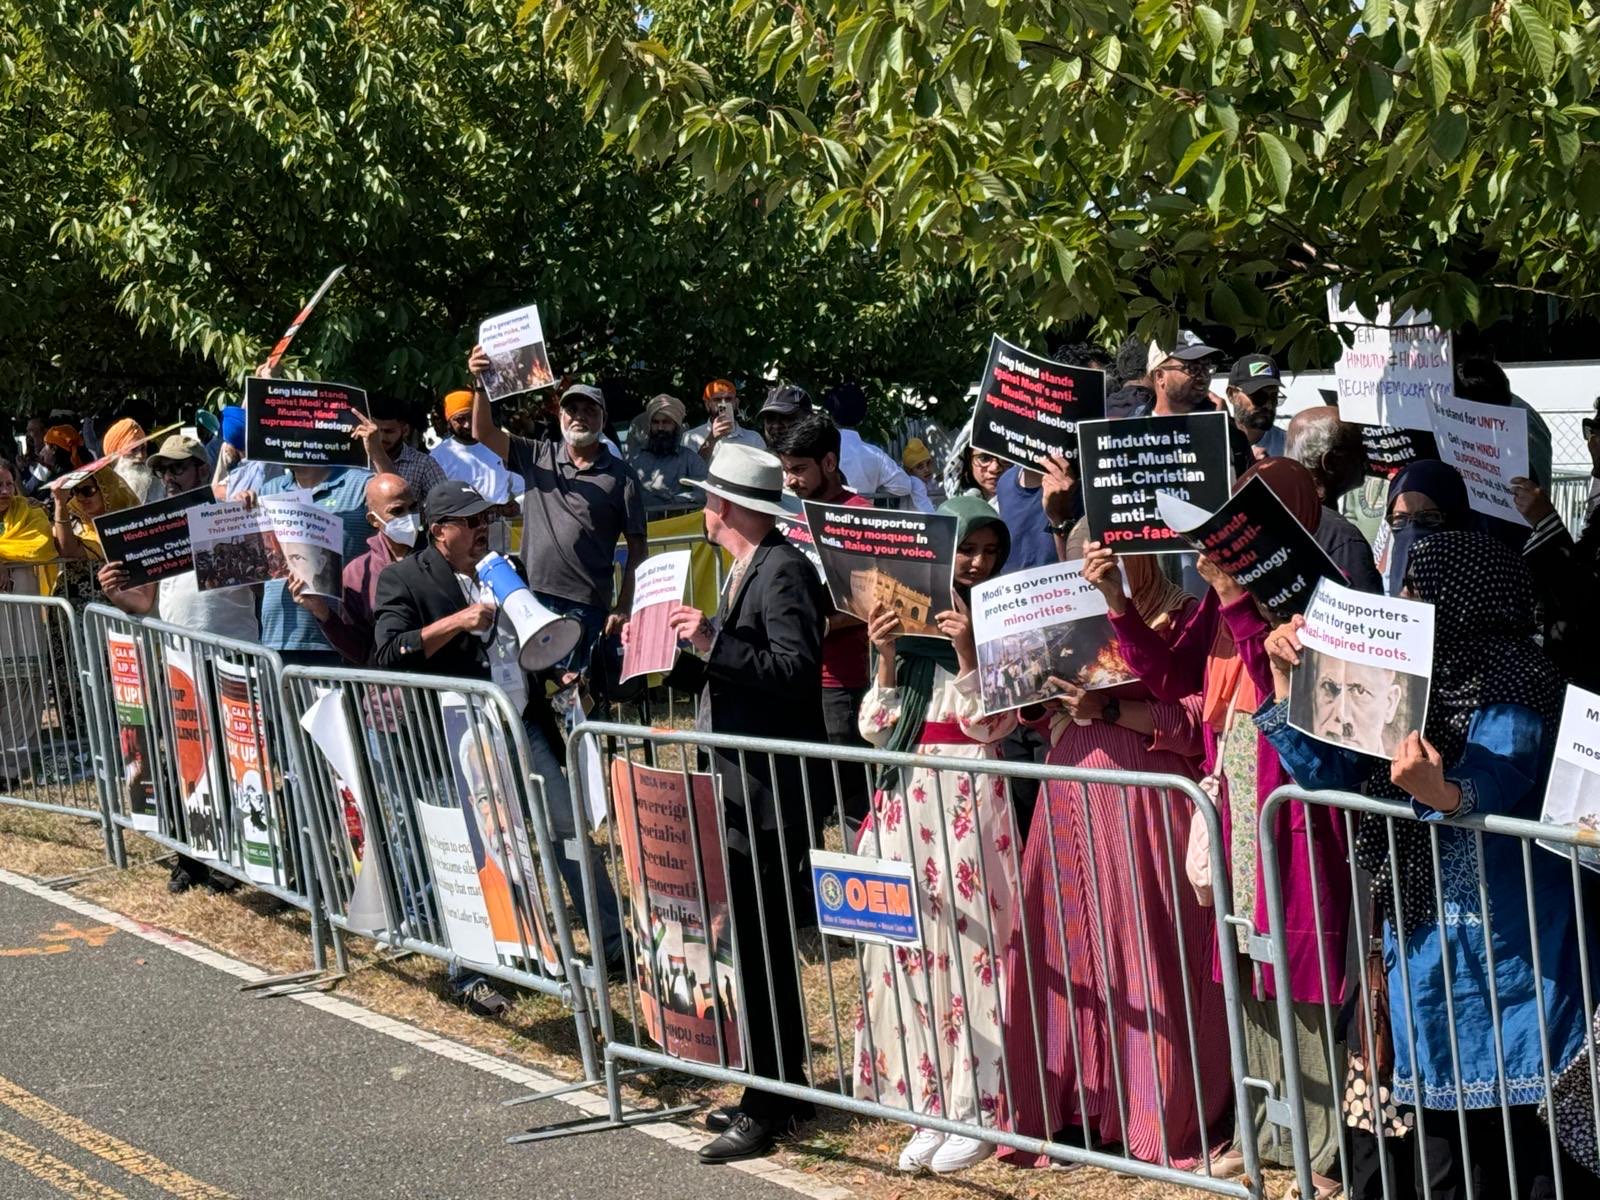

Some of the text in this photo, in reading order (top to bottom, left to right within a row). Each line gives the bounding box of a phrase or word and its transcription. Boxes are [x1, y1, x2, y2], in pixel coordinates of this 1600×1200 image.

[998, 351, 1075, 388] Long Island stands
[268, 386, 348, 399] Long Island stands
[1020, 377, 1050, 396] Modi's
[265, 397, 298, 408] against
[299, 399, 329, 408] Modi's
[1001, 384, 1063, 414] Muslim, Hindu
[277, 408, 339, 419] Muslim, Hindu
[1445, 407, 1464, 423] stand
[1464, 411, 1476, 425] for
[1477, 415, 1509, 433] UNITY.
[261, 418, 354, 433] supremacist ideology.
[265, 438, 351, 451] Get your hate out of
[989, 421, 1005, 436] Get
[1005, 427, 1025, 444] your
[1025, 435, 1046, 451] hate
[1065, 448, 1078, 458] of
[1097, 430, 1190, 450] Hindutva is:
[285, 450, 328, 460] New York.
[1008, 442, 1027, 459] New
[1475, 442, 1500, 459] HINDU
[201, 508, 222, 518] Modi
[214, 515, 245, 526] groups
[277, 508, 331, 526] supporters
[825, 512, 926, 531] Modi's supporters
[104, 520, 144, 536] Narendra
[144, 513, 166, 526] Modi
[226, 523, 247, 533] isn't
[273, 517, 304, 528] forget
[305, 522, 327, 533] your
[1204, 511, 1248, 547] stands
[123, 529, 148, 542] Hindu
[824, 525, 929, 544] destroy mosques in
[125, 545, 164, 561] Muslims,
[820, 535, 937, 559] India. Raise your voice.
[142, 554, 166, 567] Sikhs
[166, 552, 174, 560] &
[147, 565, 162, 576] pay
[163, 559, 178, 569] the
[982, 585, 1011, 602] Modi's
[1267, 574, 1307, 608] out of
[984, 597, 1028, 619] protects
[1030, 587, 1076, 606] mobs,
[1338, 601, 1409, 623] supporters
[1004, 602, 1077, 628] minorities.
[1312, 608, 1402, 641] don't forget your
[1303, 623, 1412, 662] Nazi-inspired roots.
[231, 706, 246, 717] CAA
[845, 877, 912, 917] OEM
